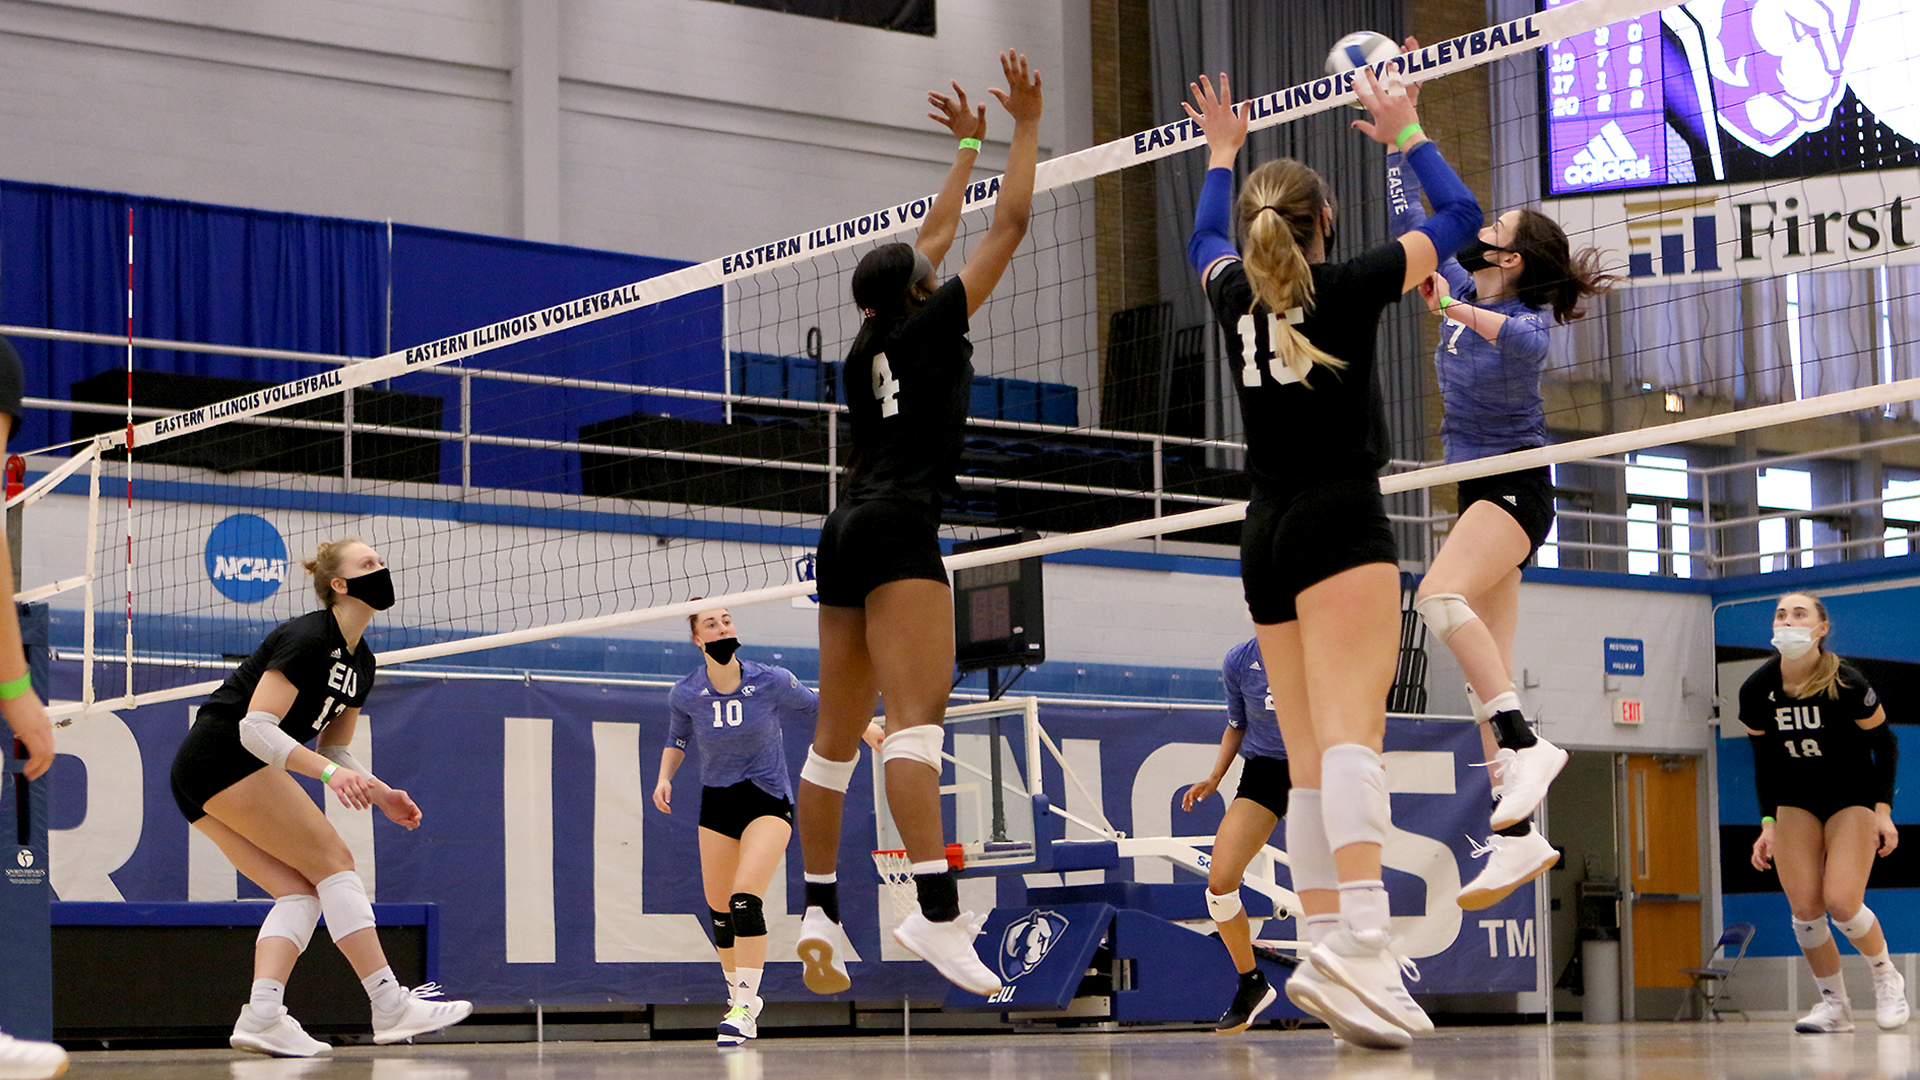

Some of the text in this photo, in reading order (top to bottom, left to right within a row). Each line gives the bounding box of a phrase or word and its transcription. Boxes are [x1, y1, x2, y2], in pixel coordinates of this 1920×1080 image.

[1551, 53, 1576, 73] 10
[1595, 49, 1610, 68] 7
[1249, 70, 1355, 121] ILLINOIS
[1552, 74, 1575, 95] 17
[1596, 71, 1607, 91] 1
[1552, 96, 1580, 117] 20
[1564, 159, 1651, 185] adidas
[722, 235, 802, 276] EASTERN
[808, 209, 891, 250] ILLINOIS
[1733, 196, 1915, 262] First
[405, 284, 641, 365] EASTERN ILLINOIS VOLLEYBALL
[1237, 306, 1314, 387] 15
[871, 351, 900, 418] 4
[155, 371, 342, 436] EASTERN ILLINOIS VOLLEYBALL
[213, 555, 285, 583] NCAA
[712, 699, 743, 728] 10
[1622, 701, 1641, 722] EXIT
[1784, 739, 1823, 758] 18
